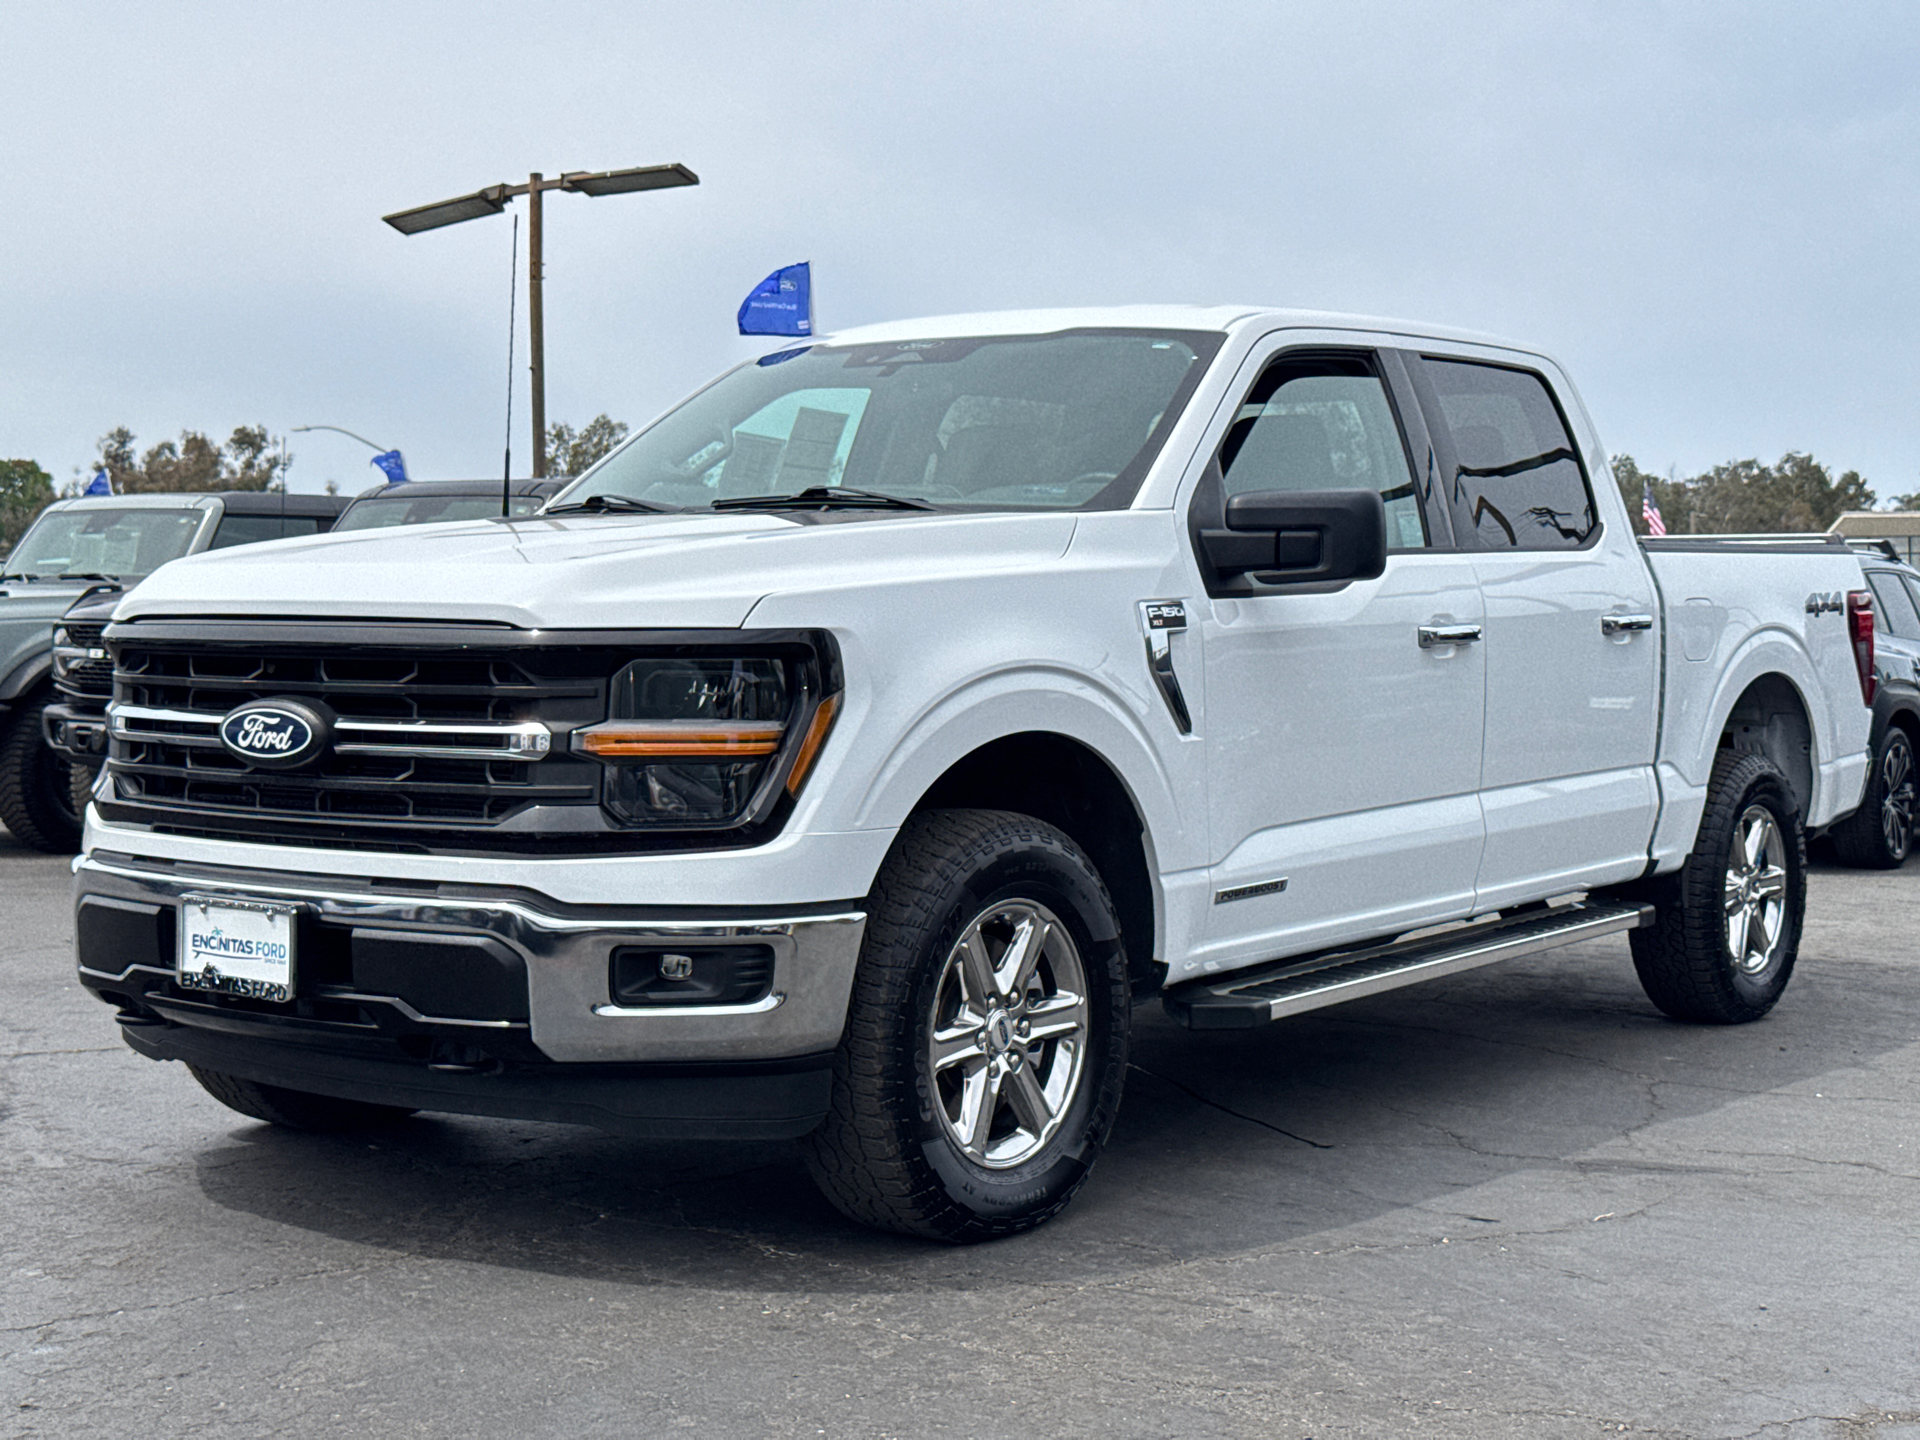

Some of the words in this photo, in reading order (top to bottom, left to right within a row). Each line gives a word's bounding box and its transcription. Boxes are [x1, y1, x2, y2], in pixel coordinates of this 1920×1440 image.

[1148, 606, 1185, 618] F-150
[238, 714, 294, 750] Ford
[1221, 880, 1285, 900] POWERBOOST
[192, 934, 253, 954] ENCINITAS
[255, 941, 286, 959] FORD
[252, 980, 287, 1001] FORD
